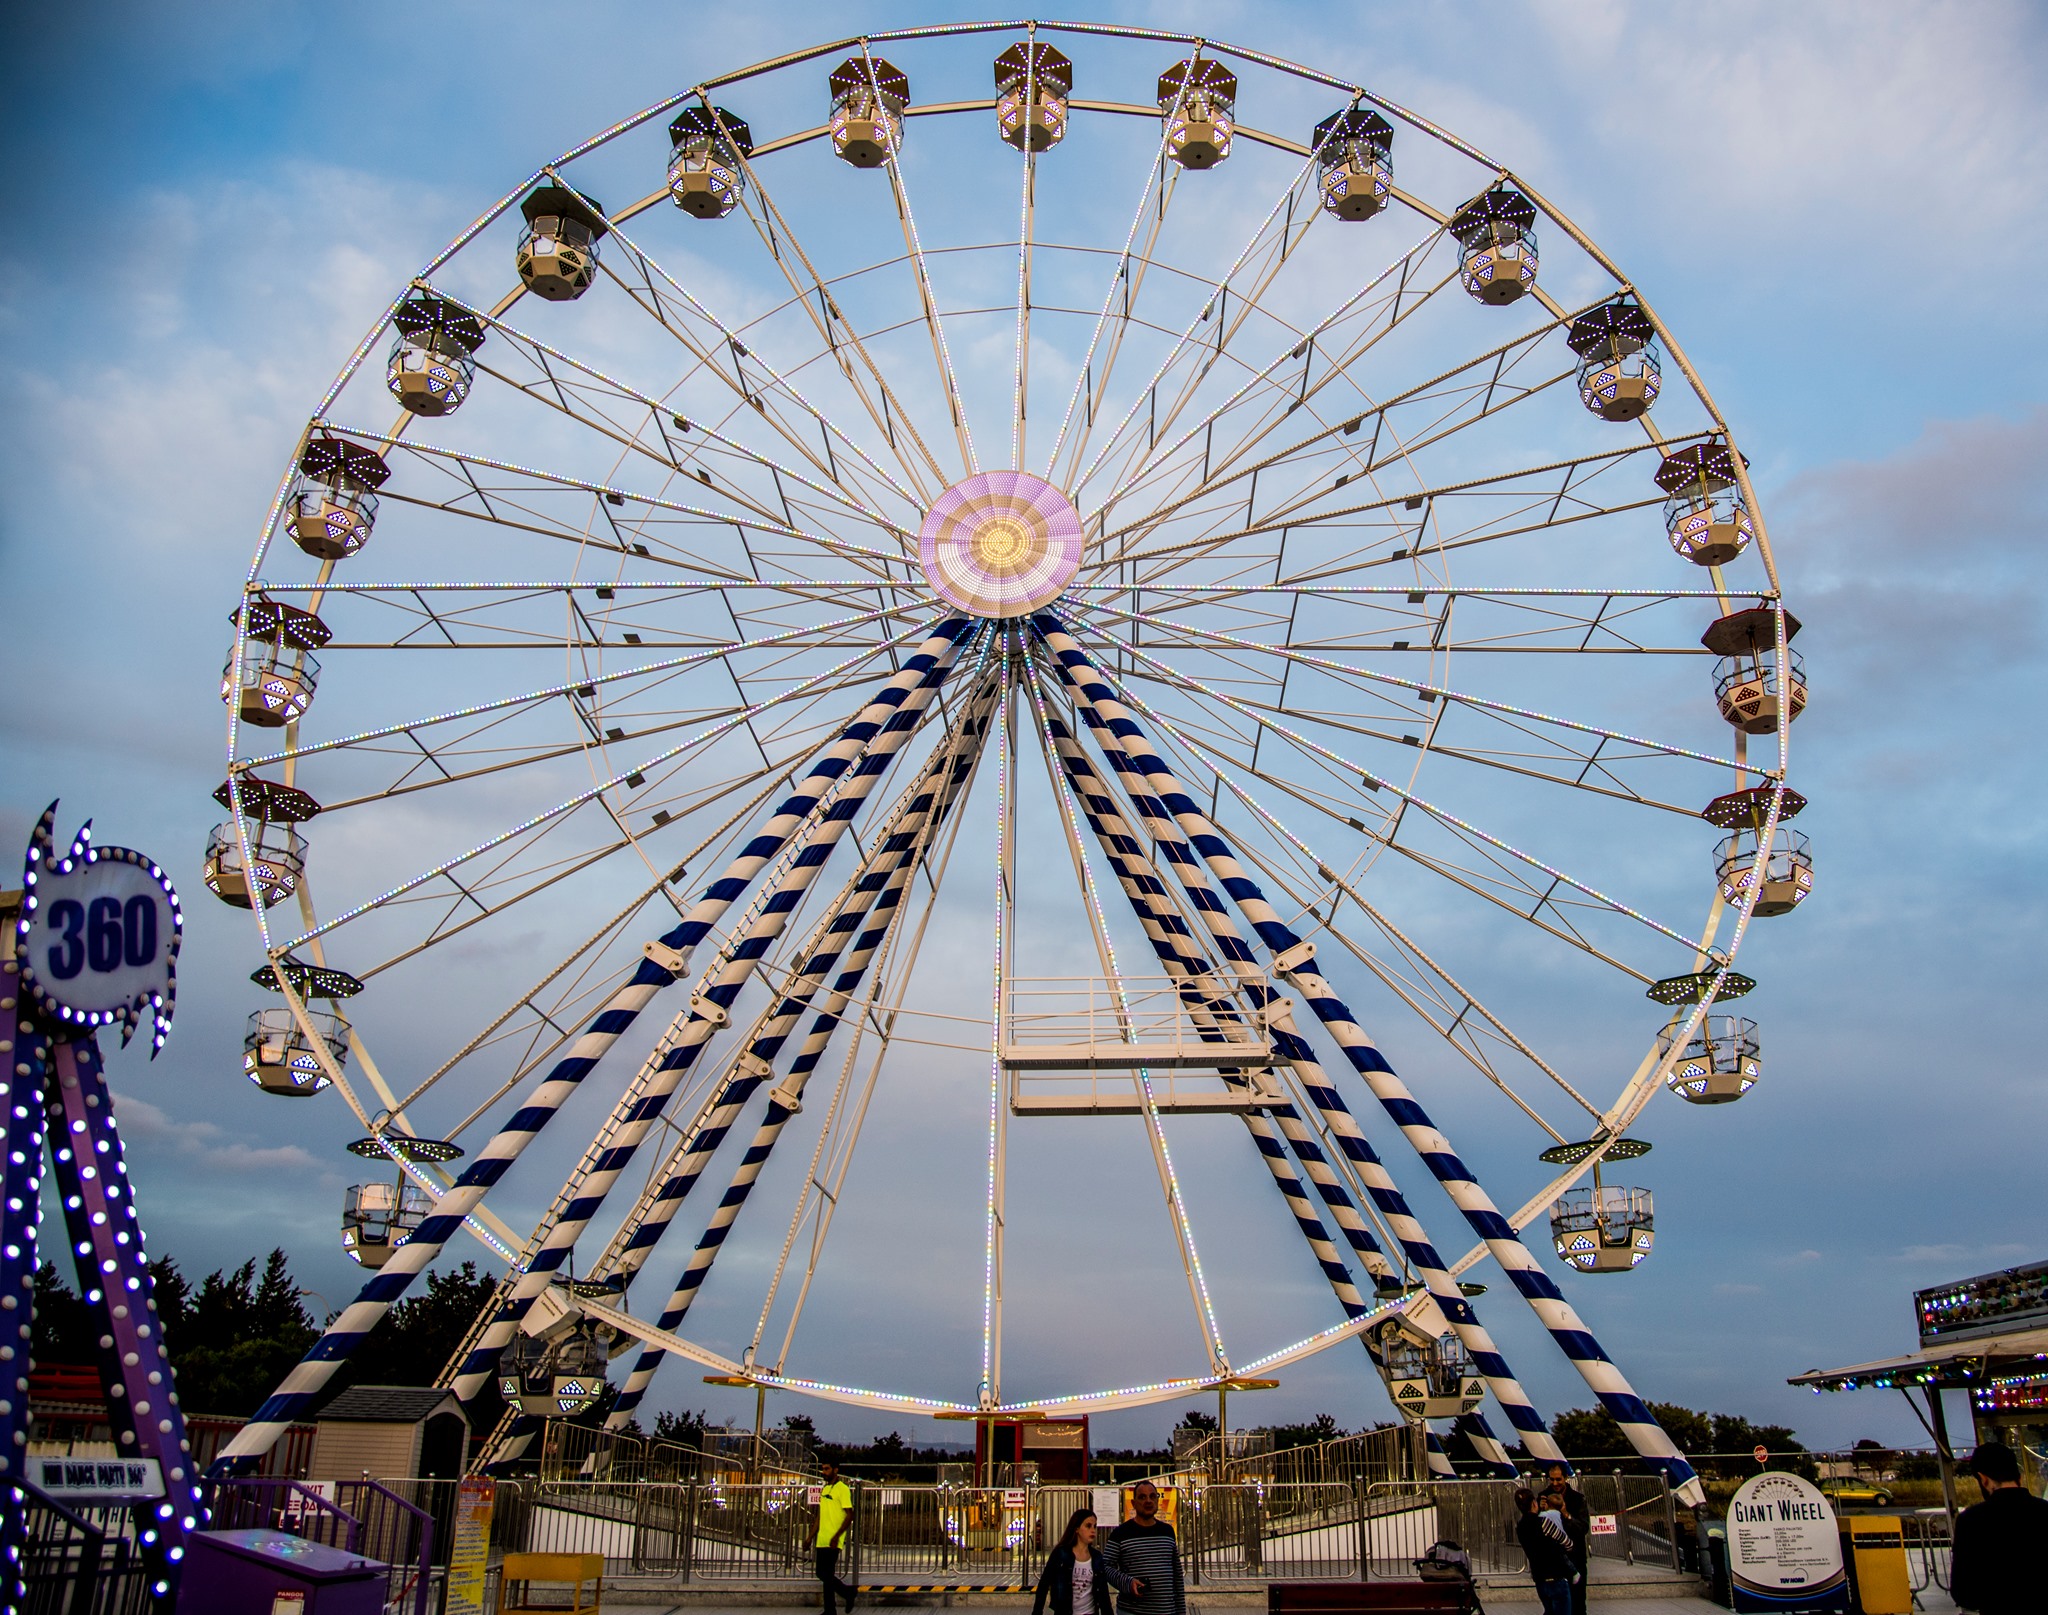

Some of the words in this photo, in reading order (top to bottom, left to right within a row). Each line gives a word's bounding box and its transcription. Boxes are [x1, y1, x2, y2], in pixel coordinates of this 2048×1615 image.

[48, 895, 157, 979] 360
[65, 1462, 97, 1488] DANCE
[97, 1462, 126, 1488] PARTY
[302, 1484, 325, 1495] XIT
[1735, 1501, 1773, 1522] GIANT
[1778, 1500, 1825, 1521] WHEEL
